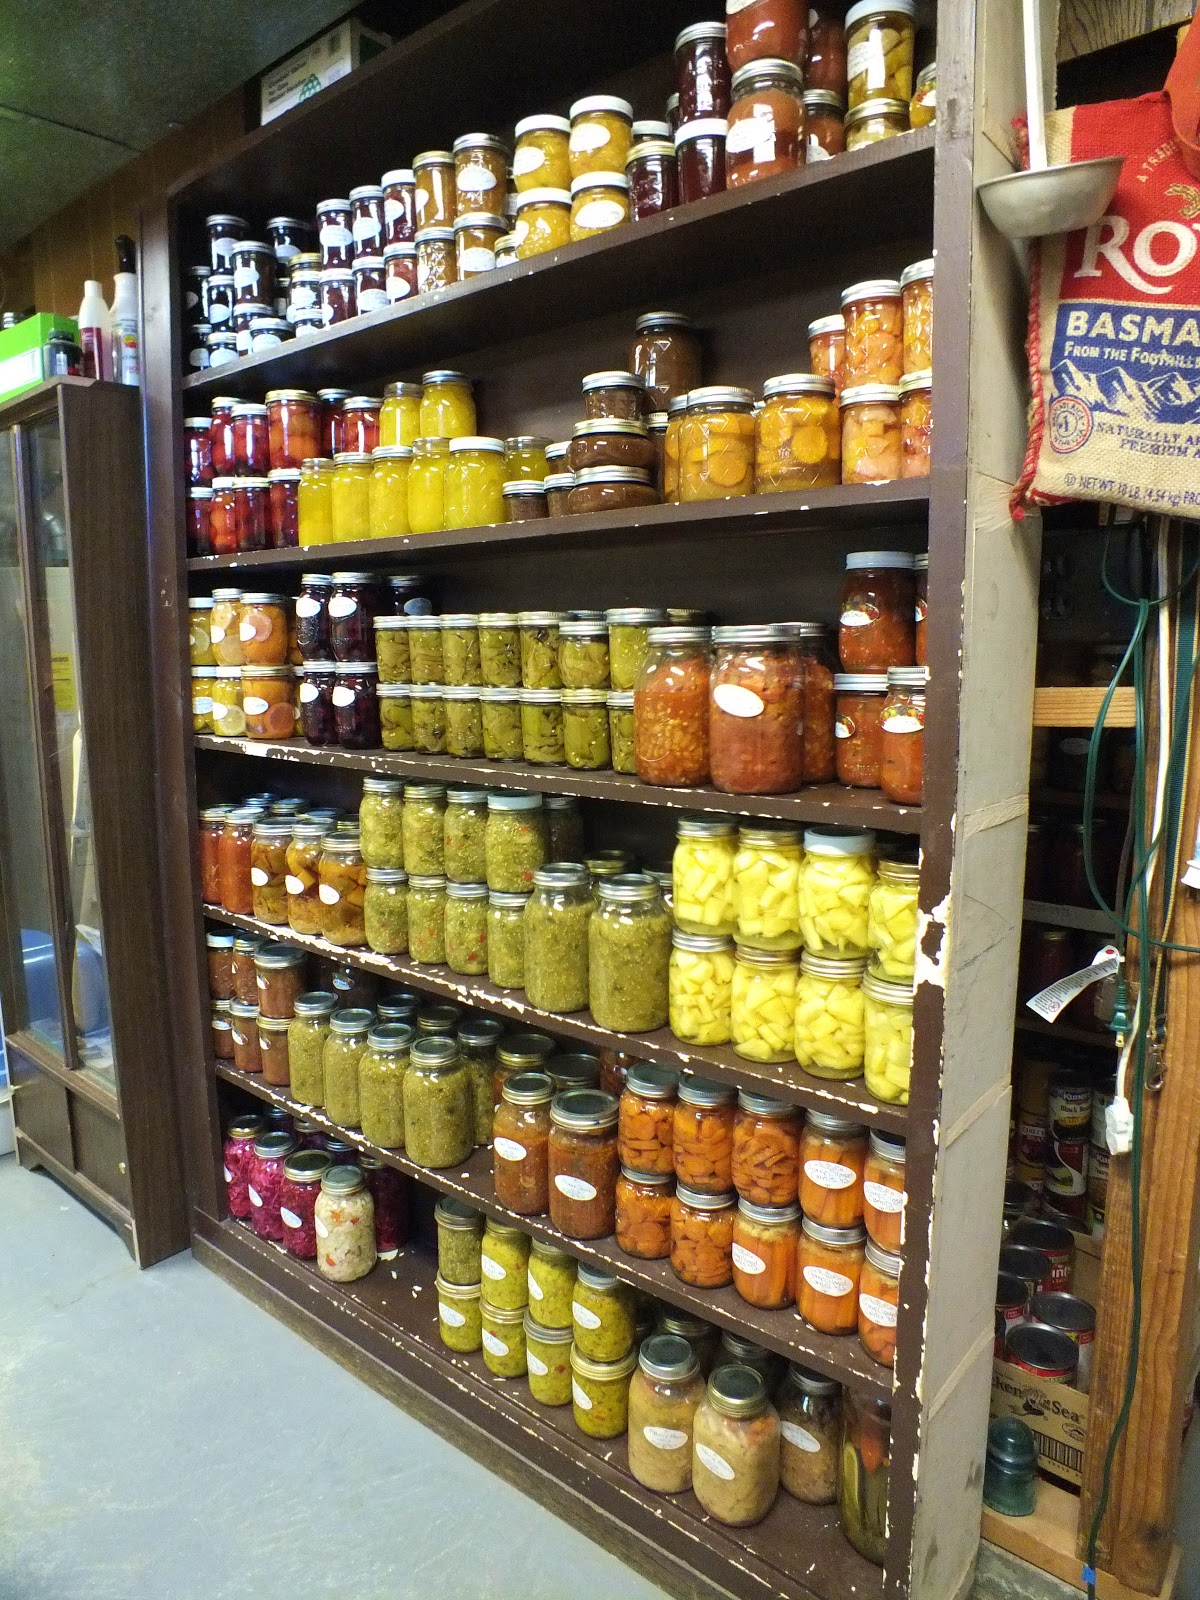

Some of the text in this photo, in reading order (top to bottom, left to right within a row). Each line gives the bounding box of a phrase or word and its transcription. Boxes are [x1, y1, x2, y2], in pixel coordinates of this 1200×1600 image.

[1073, 215, 1200, 295] RO
[1066, 310, 1200, 347] BASMA
[1064, 341, 1099, 357] FROM
[1103, 347, 1128, 361] THE
[1051, 1400, 1080, 1424] Sea
